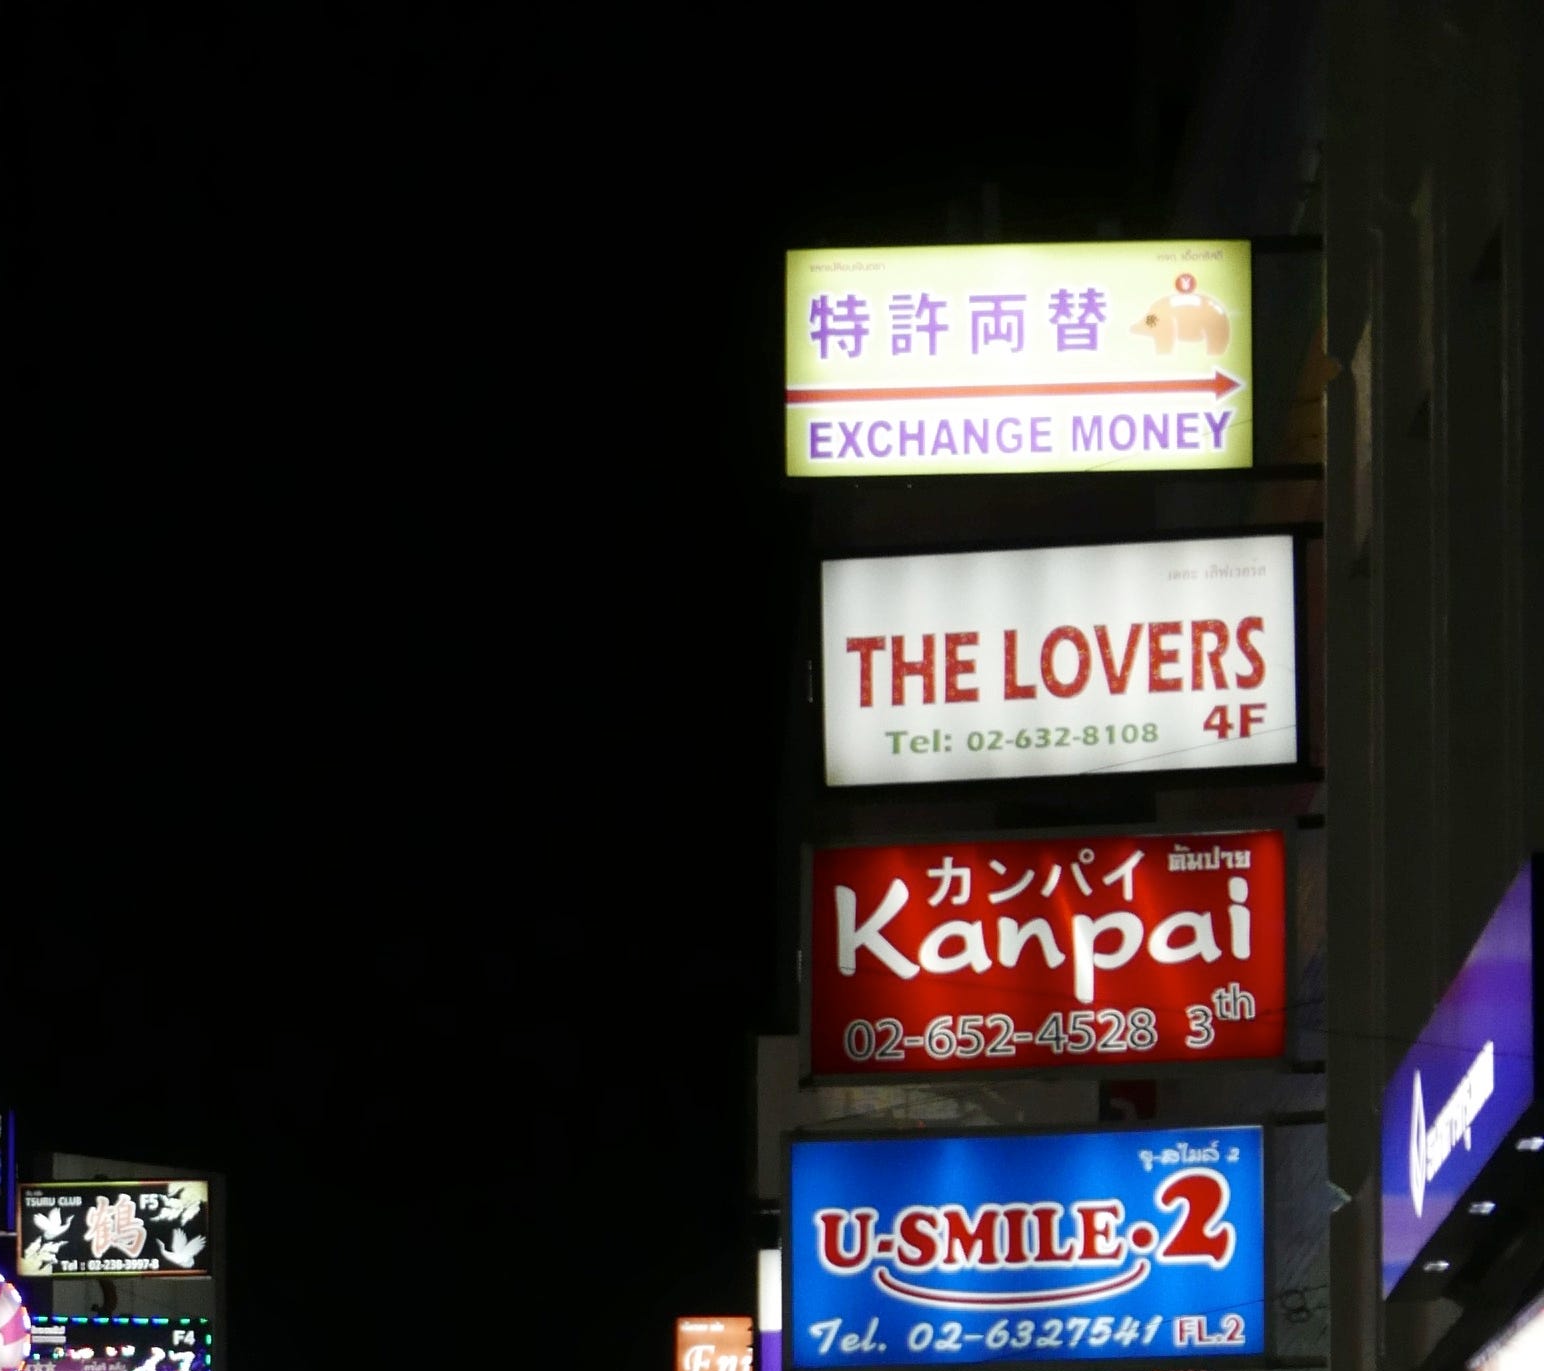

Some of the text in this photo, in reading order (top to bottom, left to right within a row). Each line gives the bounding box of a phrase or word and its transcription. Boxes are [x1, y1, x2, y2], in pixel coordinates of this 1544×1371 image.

[809, 288, 1108, 360] 特許両替
[809, 410, 1233, 460] EXCHANGE MONEY
[846, 616, 1267, 708] THE LOVERS
[885, 723, 1159, 755] Tel: 02-632-8108
[1202, 704, 1267, 740] 4F
[927, 848, 1146, 908] カンパイ
[834, 876, 1251, 1004] Kanpai
[844, 1007, 1158, 1061] 02-652-4528
[25, 1196, 83, 1208] TSURU CLUB
[84, 1194, 148, 1259] 鶴
[139, 1194, 160, 1211] F5
[172, 1329, 197, 1347] F4
[810, 1312, 1246, 1356] Tel. 02-6327541 FL.2
